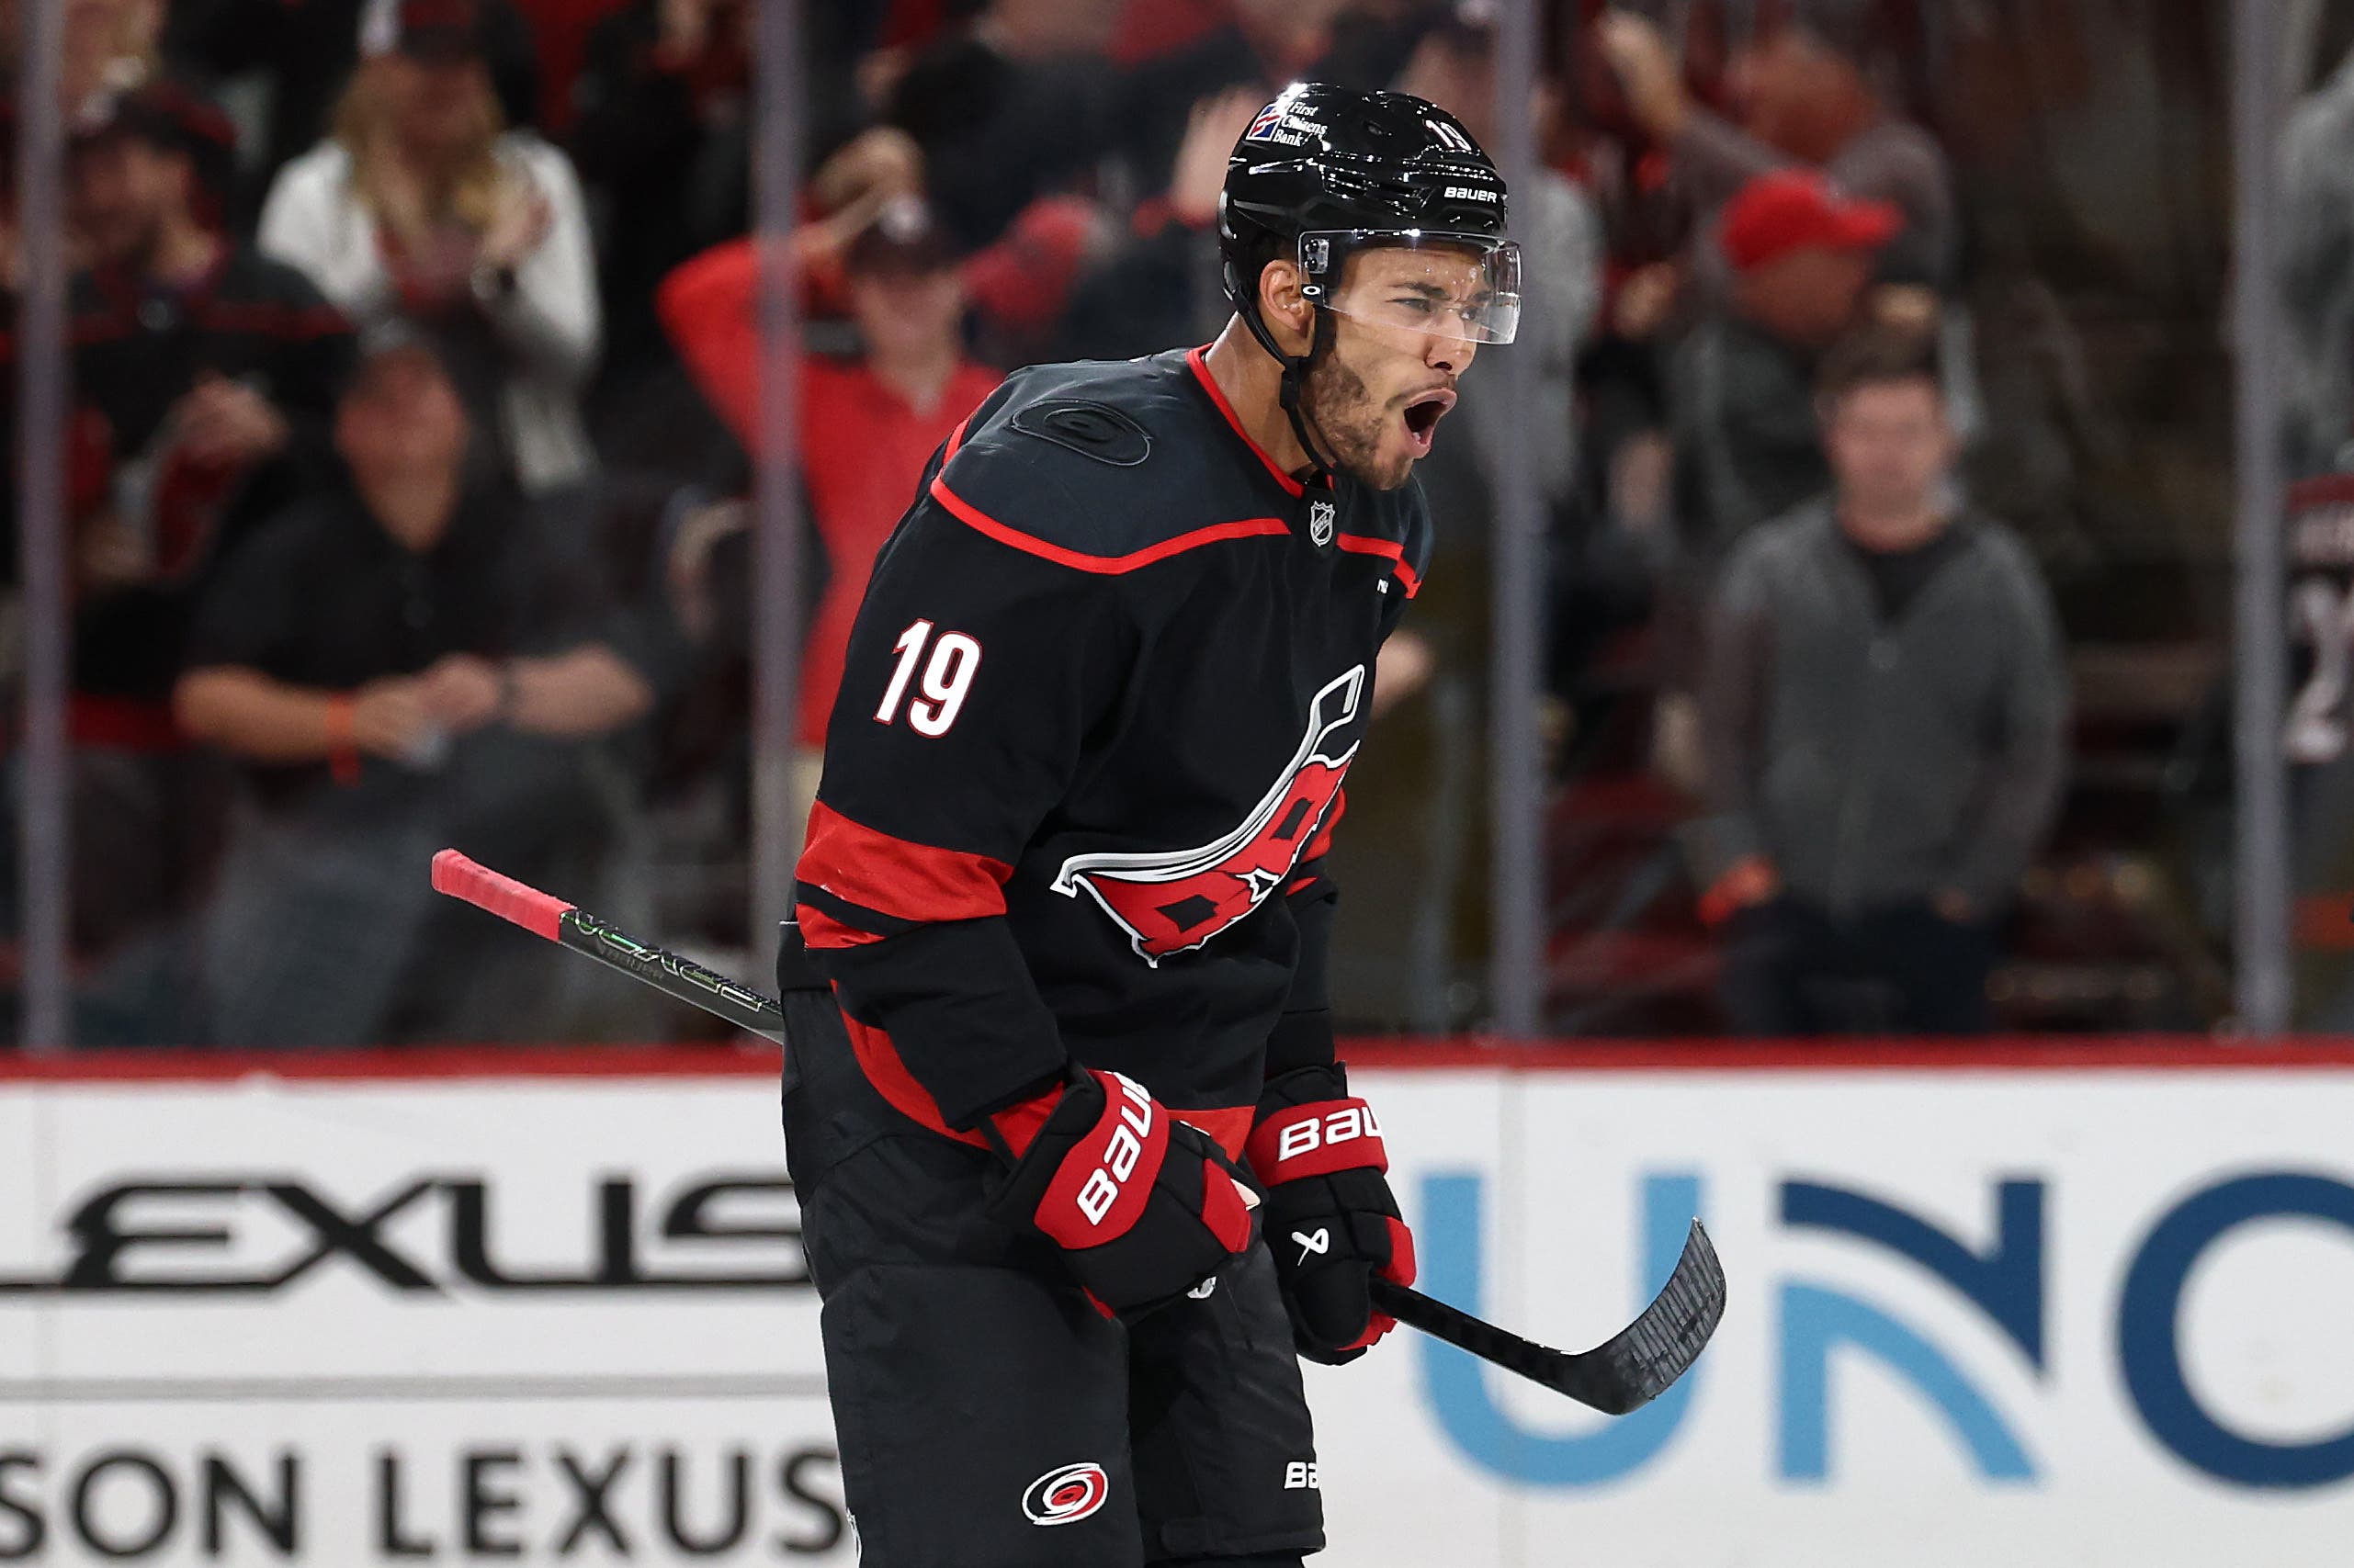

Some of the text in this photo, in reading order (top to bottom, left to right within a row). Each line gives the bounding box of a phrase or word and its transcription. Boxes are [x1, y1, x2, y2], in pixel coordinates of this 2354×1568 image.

[1272, 129, 1303, 147] Bank
[1281, 115, 1329, 136] Citizens
[1293, 101, 1318, 117] First
[1423, 119, 1473, 152] 19
[873, 617, 985, 739] 19
[1076, 1072, 1152, 1226] BAU
[0, 1178, 821, 1293] EXUS
[0, 1449, 848, 1561] SON LEXUS
